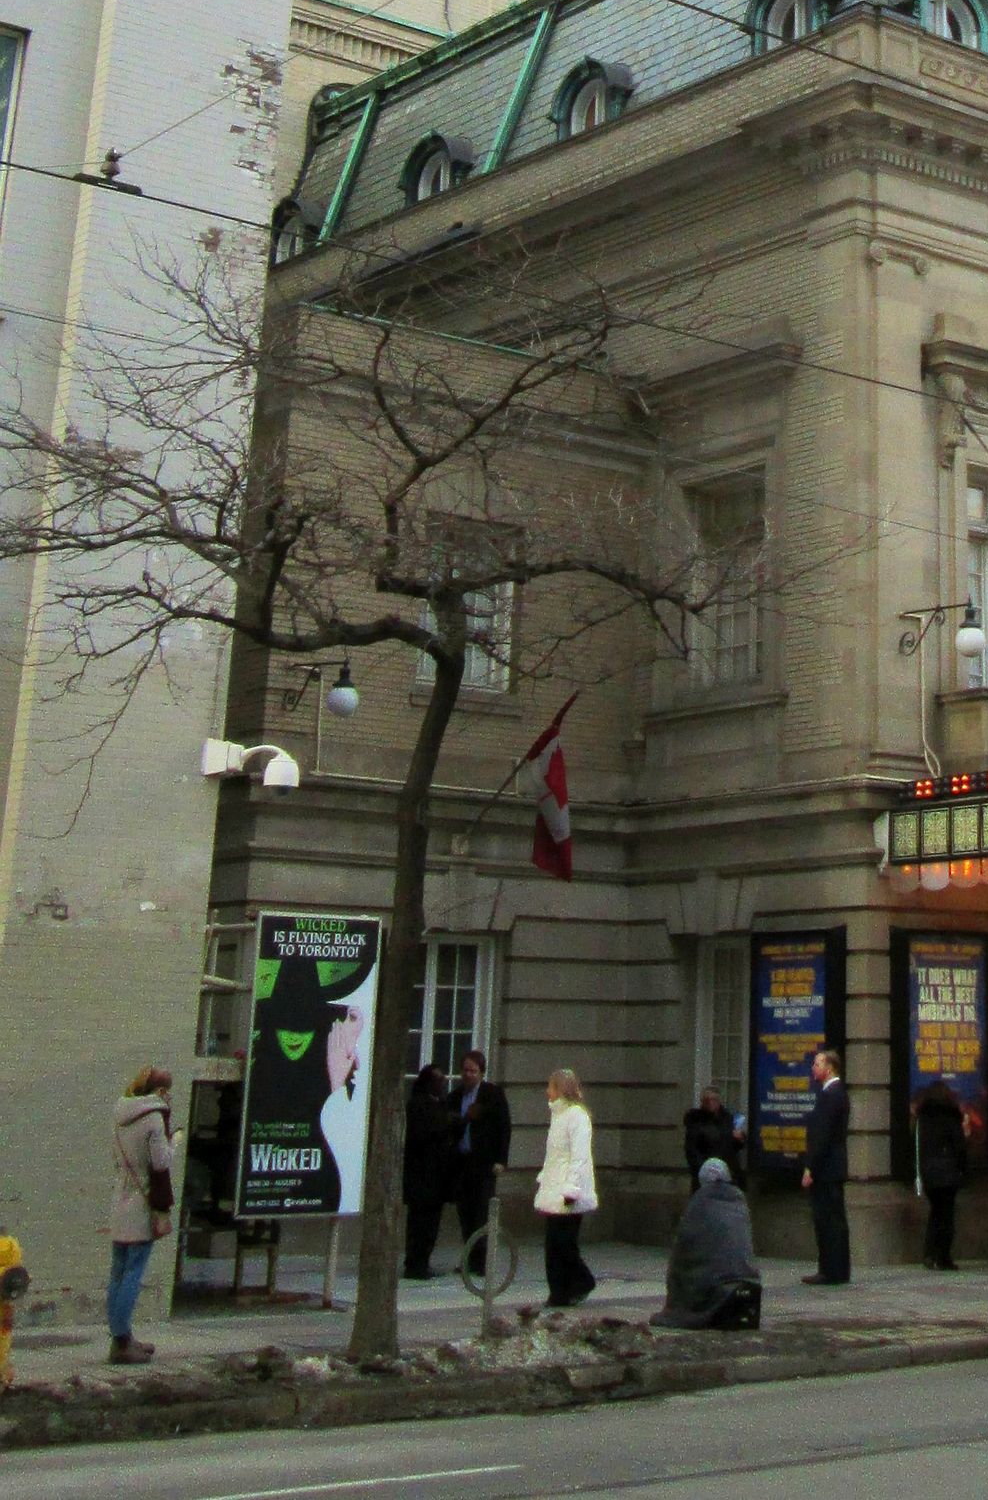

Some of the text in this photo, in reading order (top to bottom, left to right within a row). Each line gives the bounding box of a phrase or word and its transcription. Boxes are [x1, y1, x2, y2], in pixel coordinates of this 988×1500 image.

[295, 918, 347, 932] WICKED
[274, 930, 366, 946] IS FLYING BACK
[279, 943, 359, 958] TO TORONTO!
